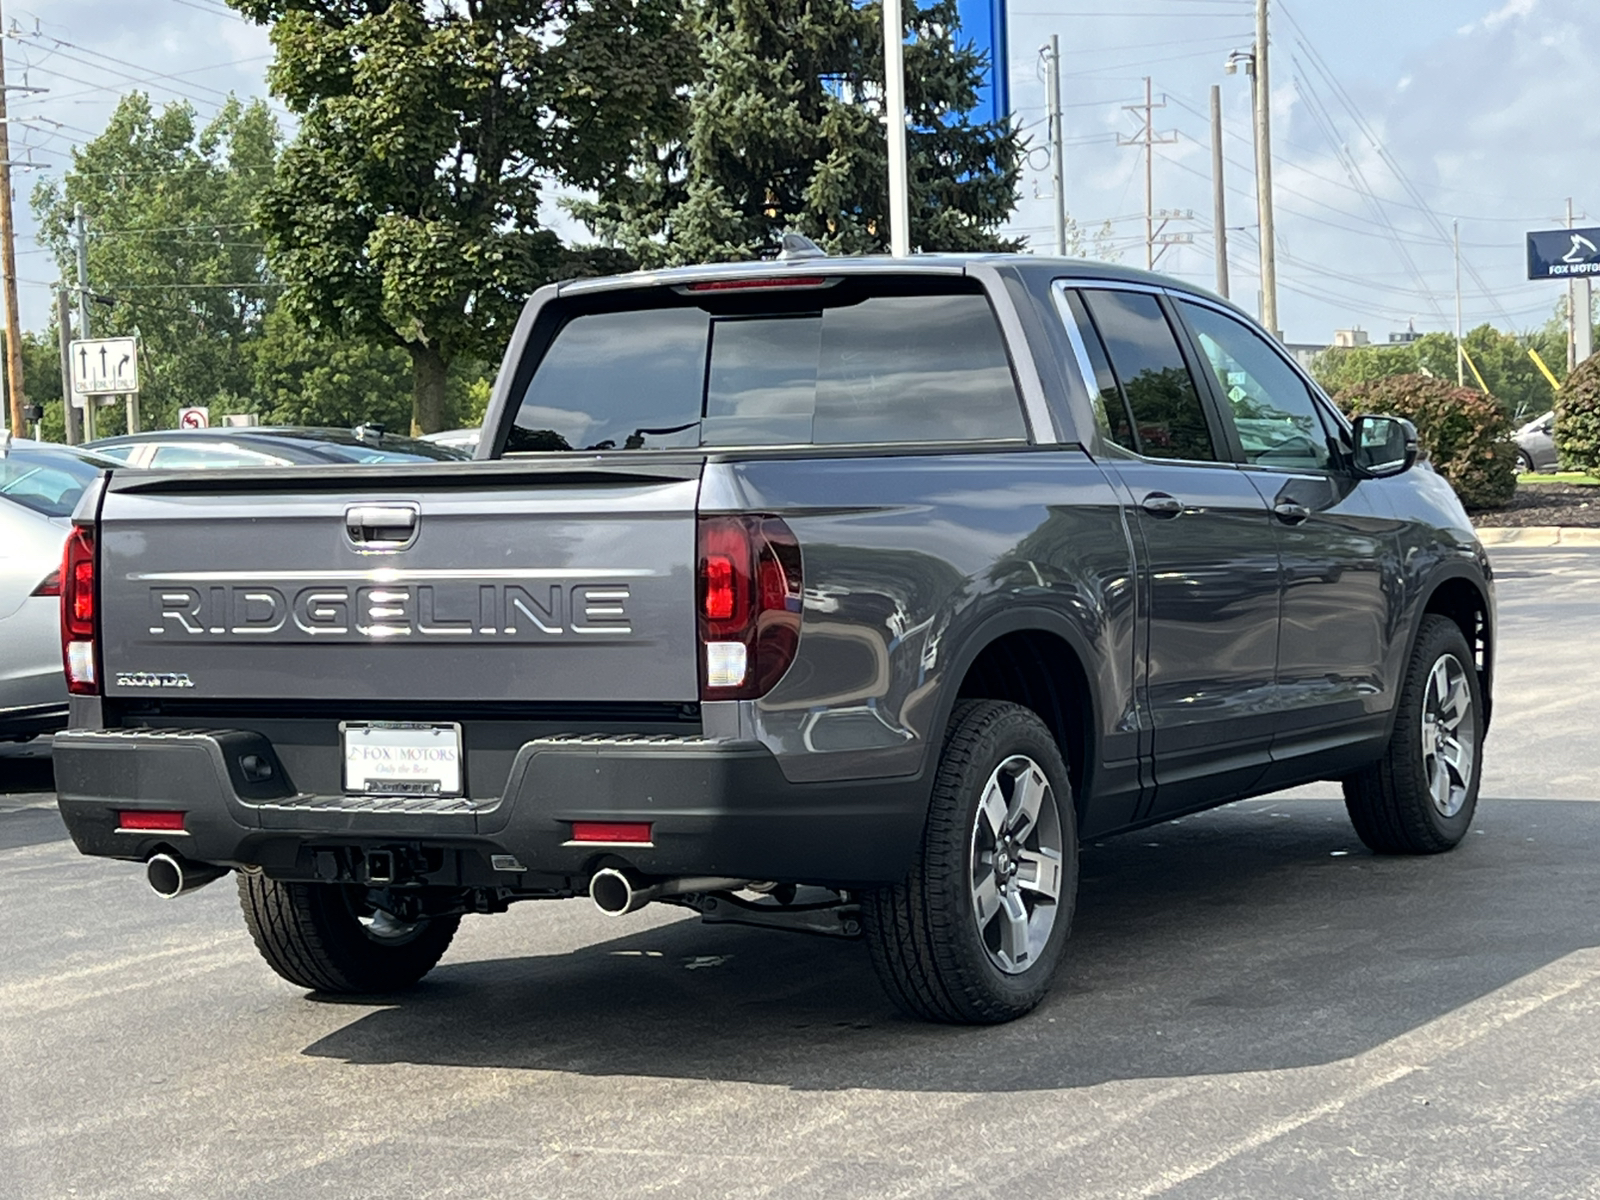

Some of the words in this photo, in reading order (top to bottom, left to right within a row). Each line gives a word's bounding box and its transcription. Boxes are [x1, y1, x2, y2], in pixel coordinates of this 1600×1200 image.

[1548, 264, 1569, 275] FOX
[1570, 262, 1600, 273] MOTO
[76, 381, 94, 390] ONLY
[96, 380, 114, 389] ONLY
[117, 379, 134, 388] ONLY
[149, 584, 632, 635] RIDGELINE
[115, 671, 195, 687] HONDA
[363, 747, 391, 760] FOX
[399, 747, 456, 761] MOTORS
[375, 762, 396, 775] Only
[398, 763, 410, 774] the
[412, 763, 429, 774] Best
